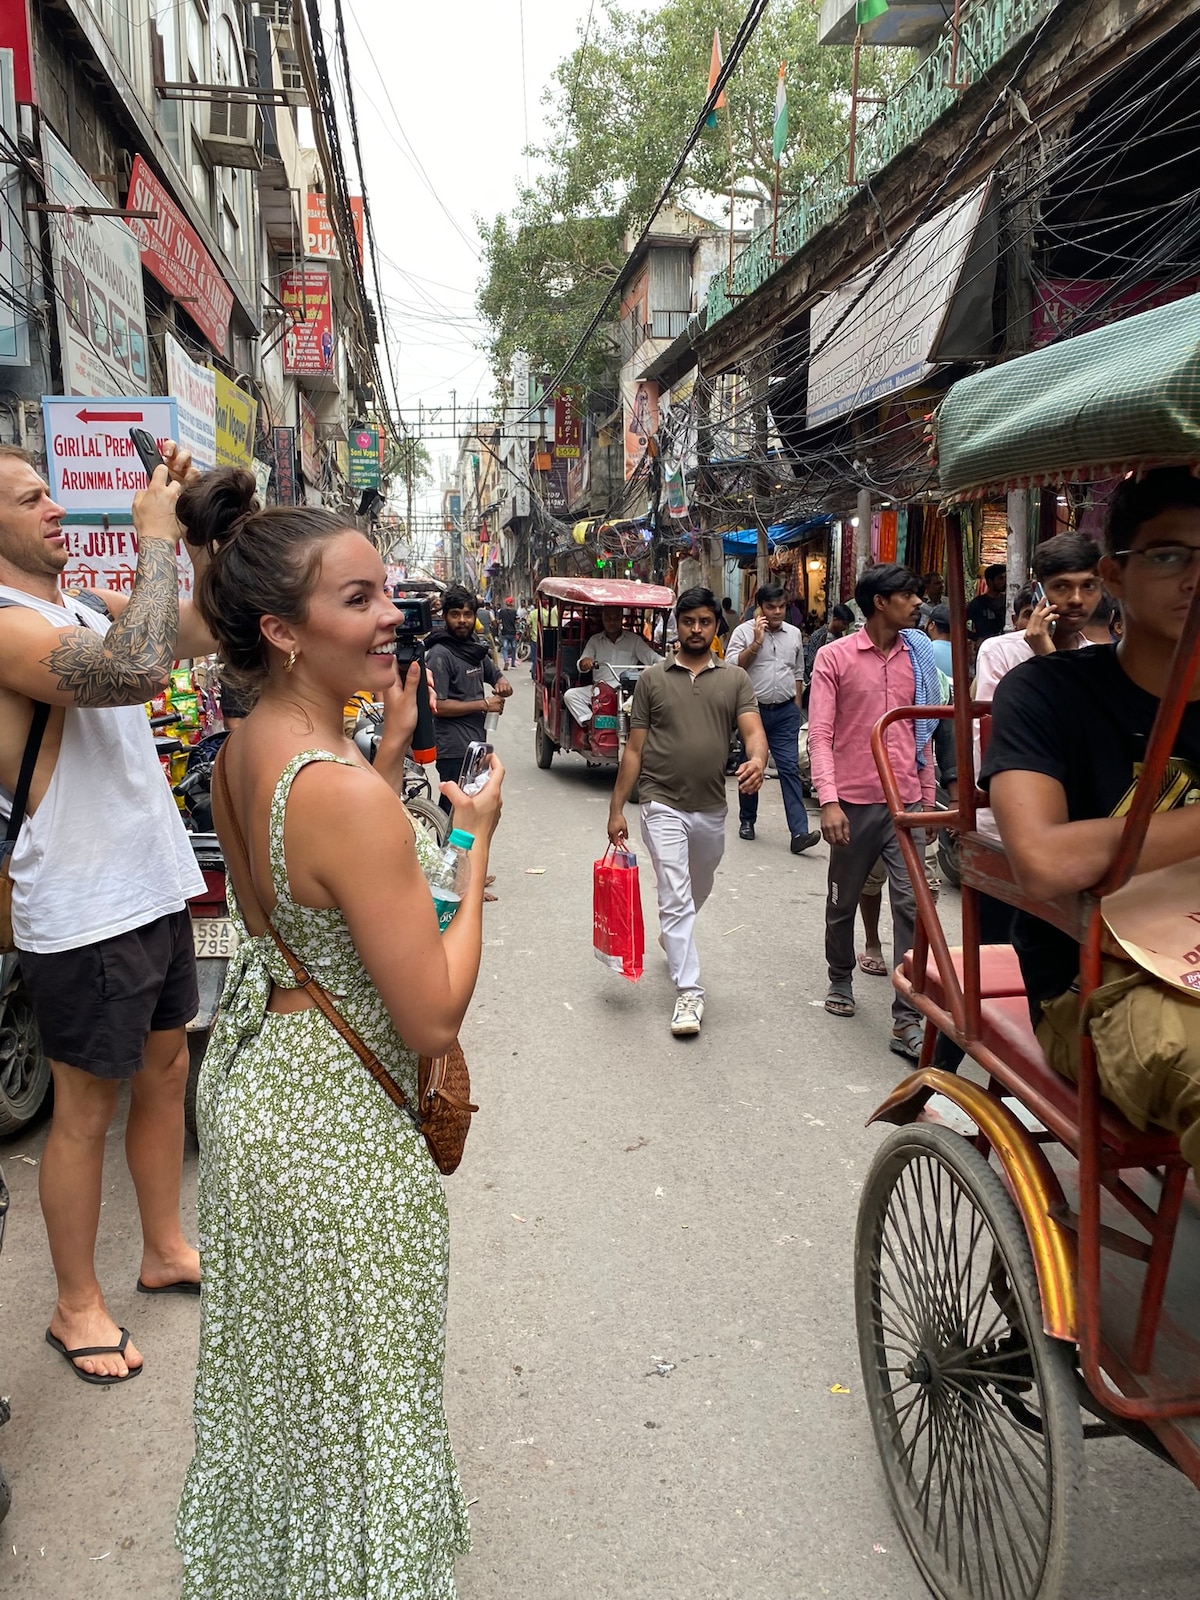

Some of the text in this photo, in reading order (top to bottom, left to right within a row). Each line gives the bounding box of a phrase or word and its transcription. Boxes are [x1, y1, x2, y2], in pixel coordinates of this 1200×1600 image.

[133, 177, 175, 248] SHALU
[174, 231, 199, 280] SILK
[198, 263, 206, 292] &
[205, 274, 231, 328] SAREES
[185, 369, 215, 418] FABRICS
[54, 434, 79, 457] GIRI
[81, 434, 102, 457] LAL
[104, 434, 135, 457] PREM
[61, 467, 114, 490] ARUNIMA
[83, 532, 127, 558] JUTE
[194, 923, 230, 939] 5SA
[197, 940, 229, 956] 795
